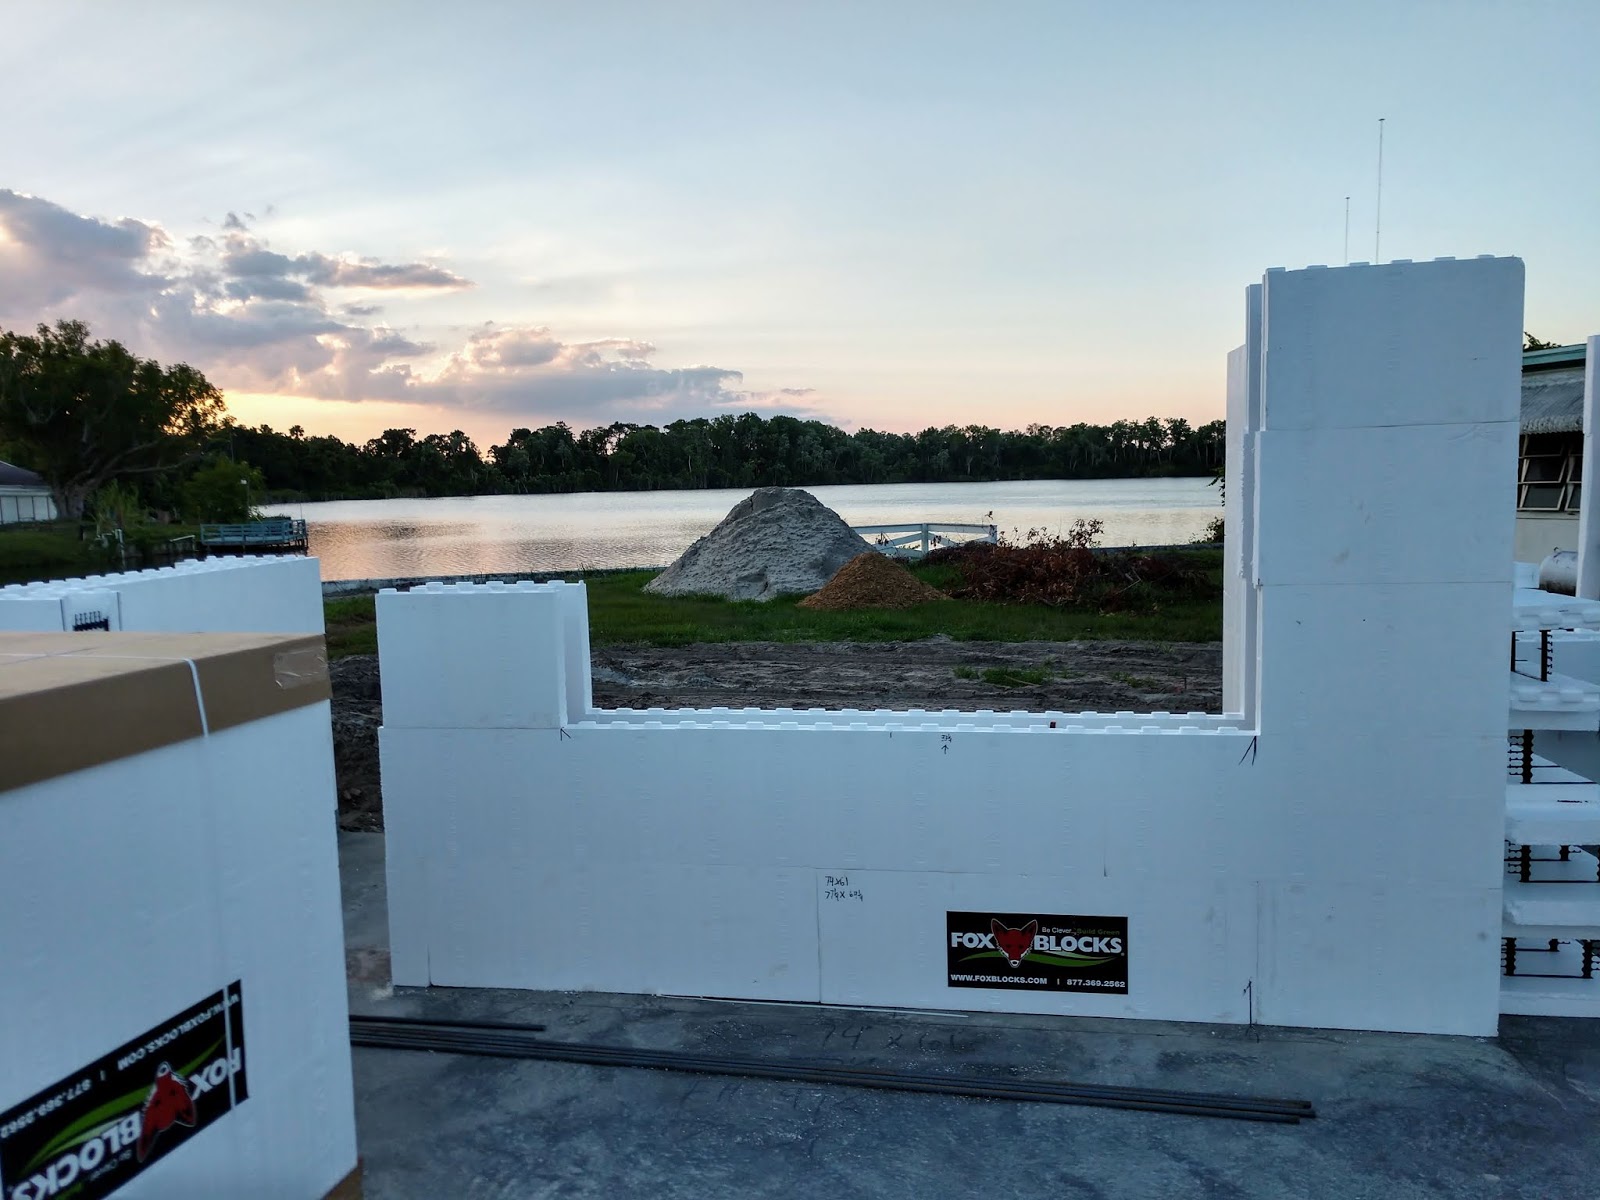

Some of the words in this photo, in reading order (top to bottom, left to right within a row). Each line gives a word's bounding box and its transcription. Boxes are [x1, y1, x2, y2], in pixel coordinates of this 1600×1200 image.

[951, 932, 994, 949] FOX
[1033, 934, 1123, 954] BLOCKS
[950, 974, 1048, 985] WWW.FOXBLOCKS.COM
[188, 1046, 242, 1101] FOX
[13, 1111, 141, 1200] BLOCKS
